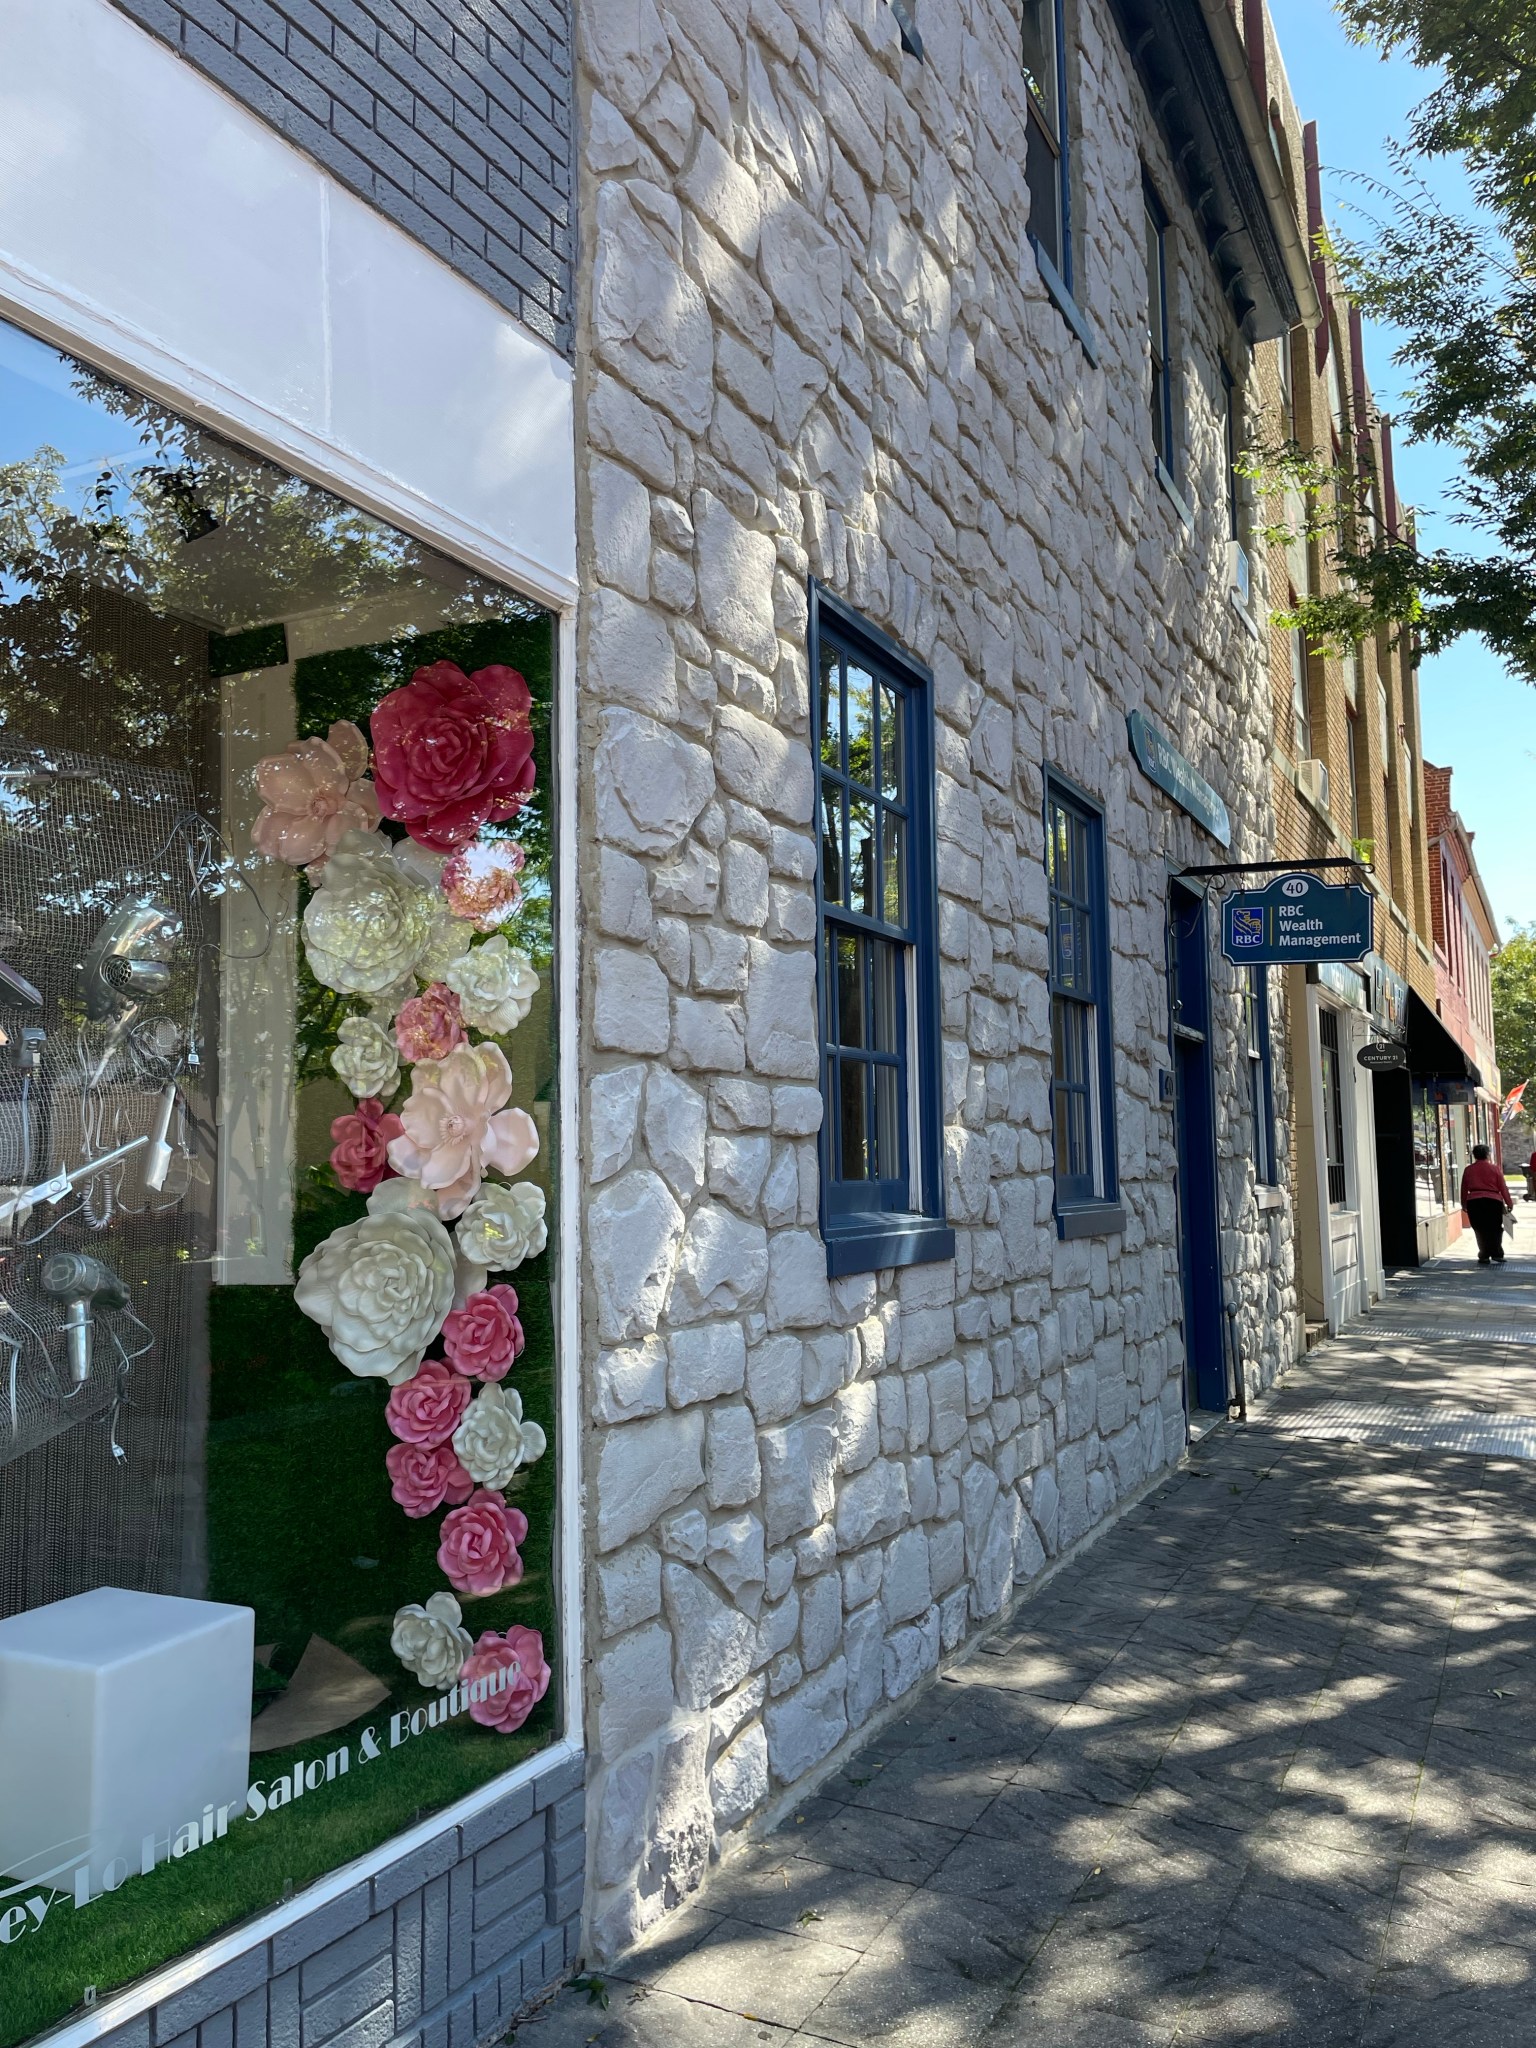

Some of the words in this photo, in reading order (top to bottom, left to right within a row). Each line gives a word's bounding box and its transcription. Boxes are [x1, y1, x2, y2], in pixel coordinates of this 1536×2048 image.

[1286, 882, 1303, 894] 40
[1279, 904, 1304, 917] RBC
[1279, 918, 1323, 932] Wealth
[1235, 934, 1260, 944] RBC
[1279, 933, 1361, 947] Management
[141, 1800, 237, 1876] Hair
[245, 1745, 349, 1822] Salon
[357, 1726, 382, 1764] &
[390, 1660, 522, 1749] Boutique
